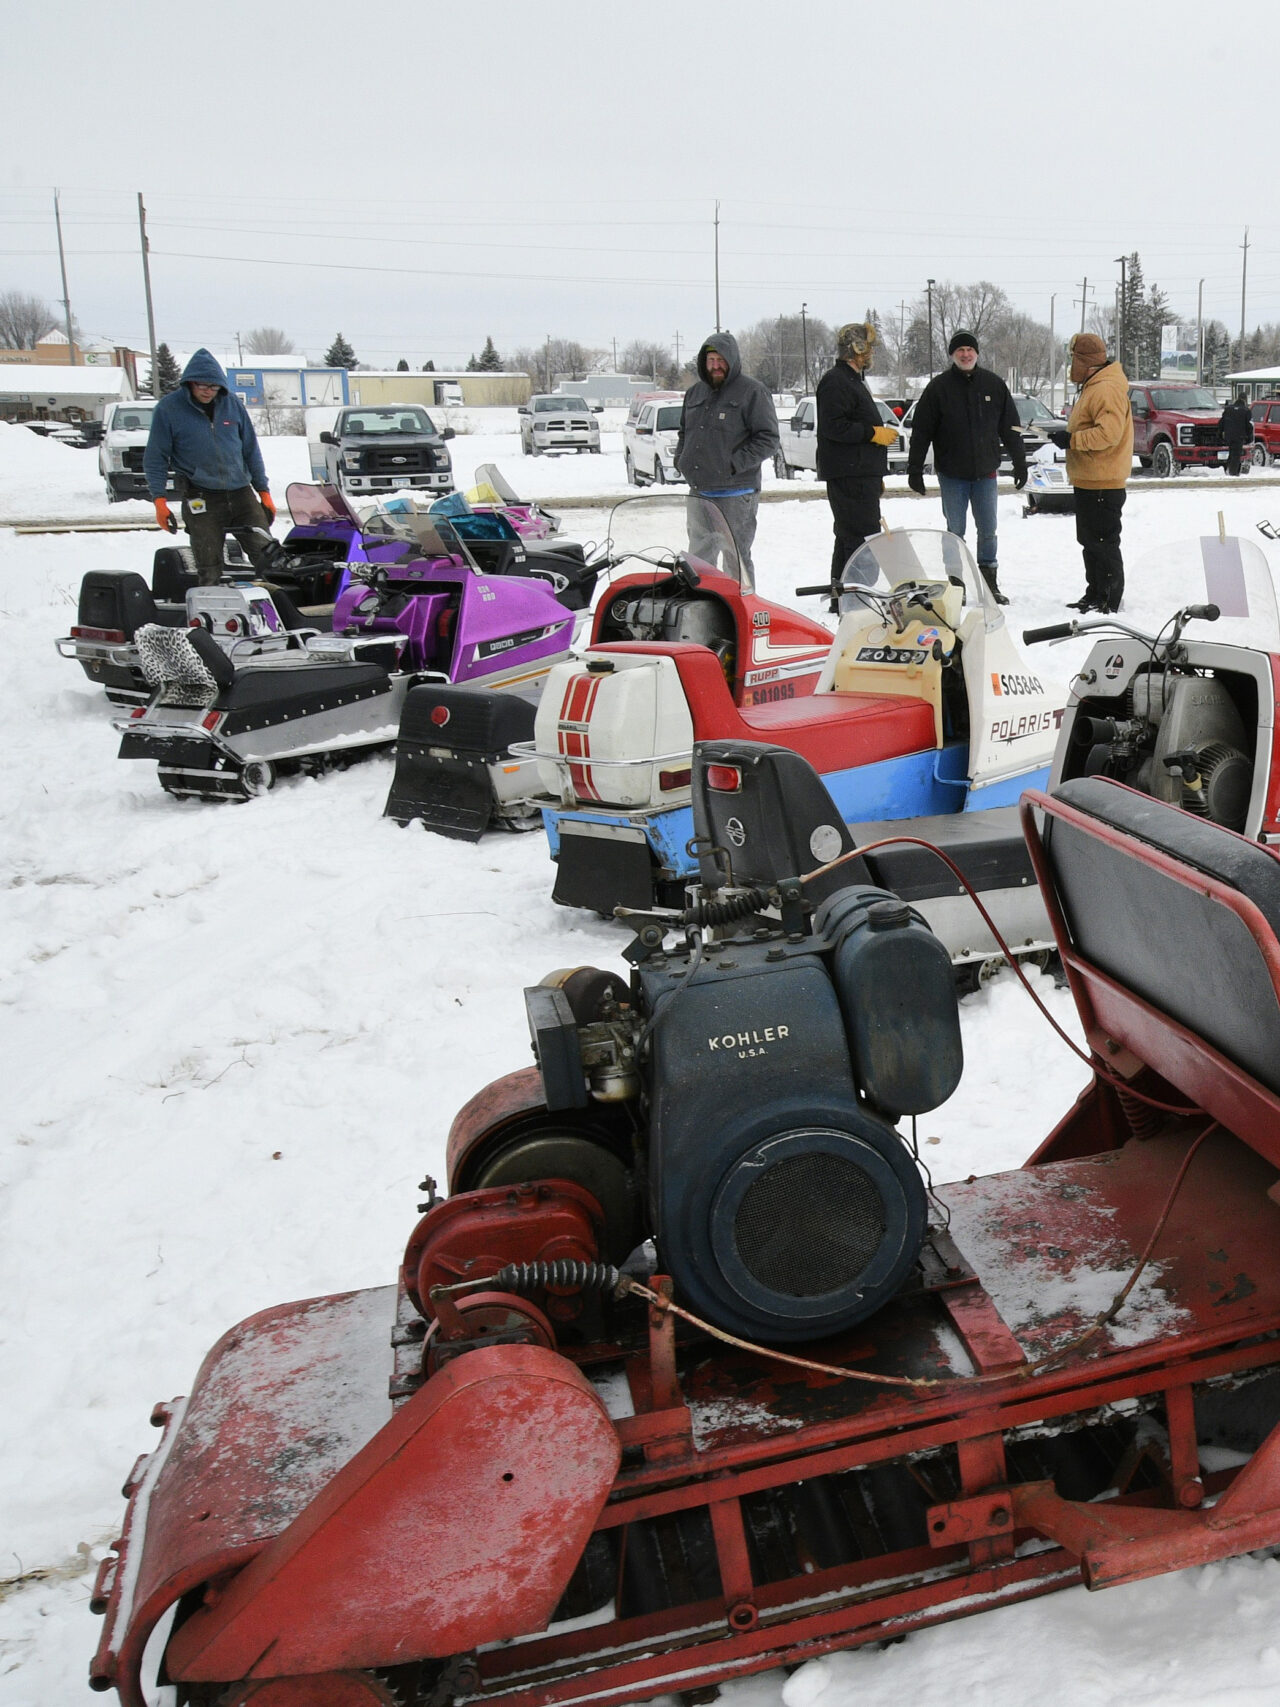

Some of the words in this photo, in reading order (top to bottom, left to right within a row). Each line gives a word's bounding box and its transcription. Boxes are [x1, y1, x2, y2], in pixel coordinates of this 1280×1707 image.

[752, 611, 770, 627] 400
[749, 668, 779, 684] RUPP
[991, 712, 1051, 741] POLARIS
[708, 1025, 789, 1051] KOHLER
[738, 1047, 769, 1059] U.S.A.
